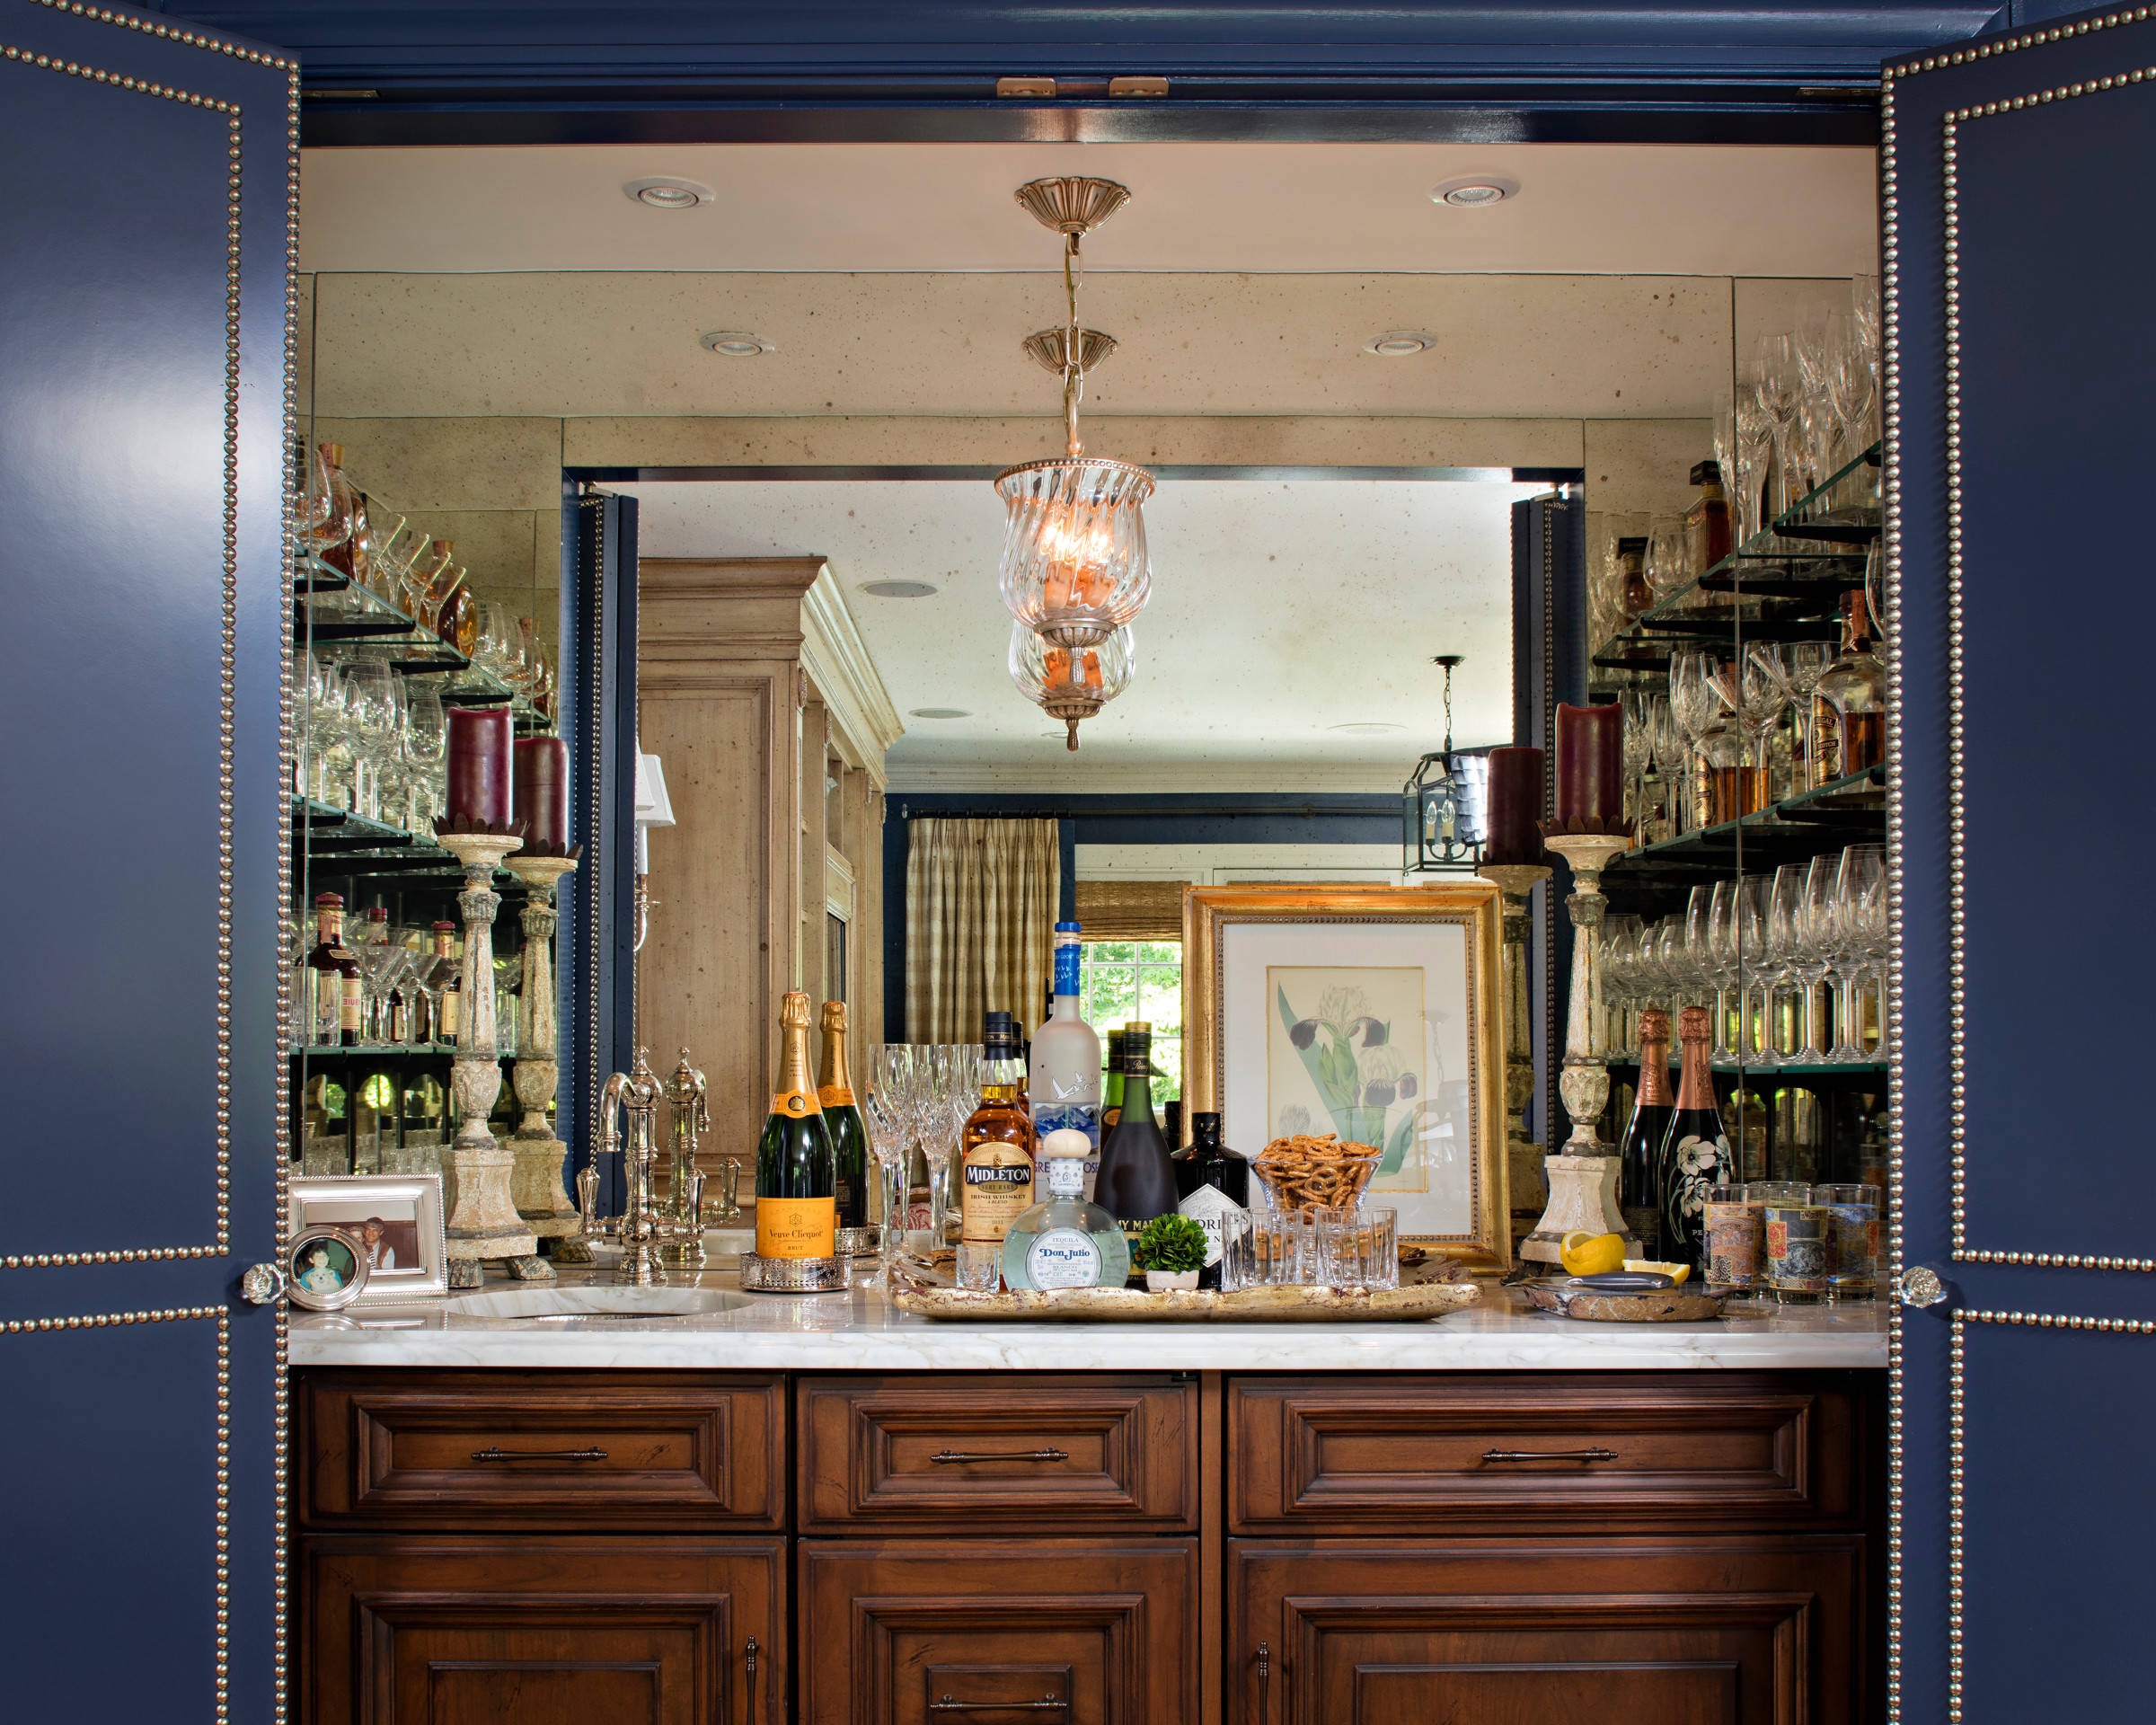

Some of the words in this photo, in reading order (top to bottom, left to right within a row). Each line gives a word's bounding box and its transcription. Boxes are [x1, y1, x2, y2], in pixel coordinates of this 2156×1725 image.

[967, 1166, 1029, 1182] MIDLETON
[769, 1229, 790, 1238] Veuve
[791, 1229, 824, 1239] Clicquot
[1038, 1248, 1065, 1258] Don
[1064, 1249, 1091, 1261] Julio
